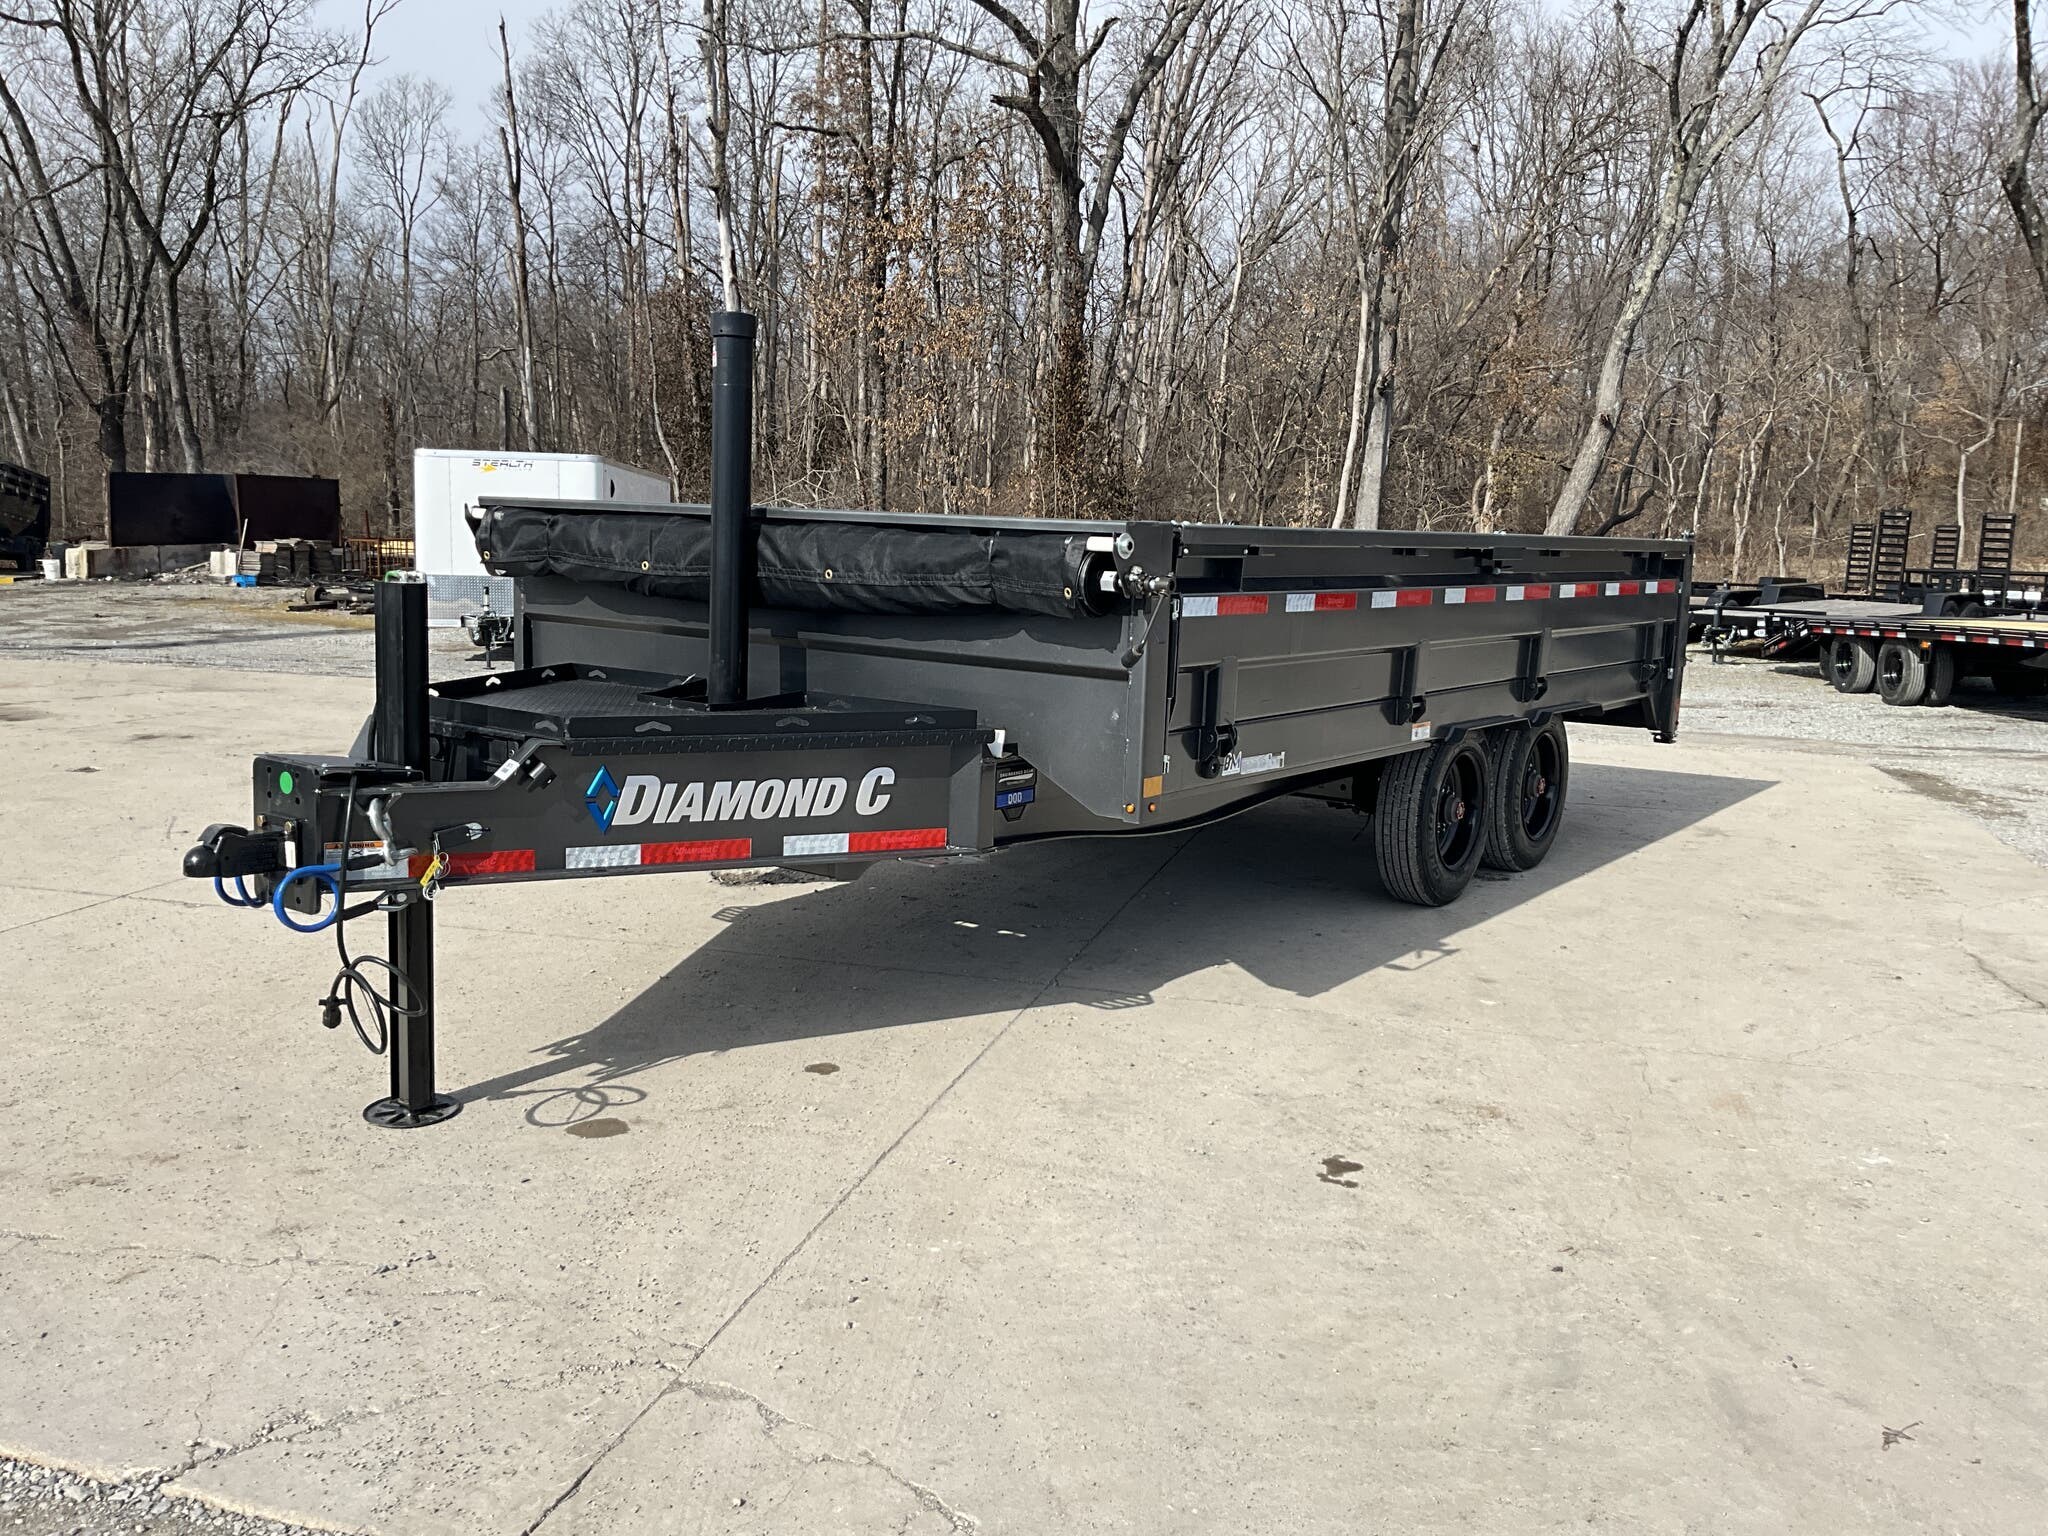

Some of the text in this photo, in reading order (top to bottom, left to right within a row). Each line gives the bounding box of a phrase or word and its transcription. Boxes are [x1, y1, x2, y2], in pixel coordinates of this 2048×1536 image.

[472, 459, 534, 468] STEALTH
[612, 766, 896, 826] DIAMOND C
